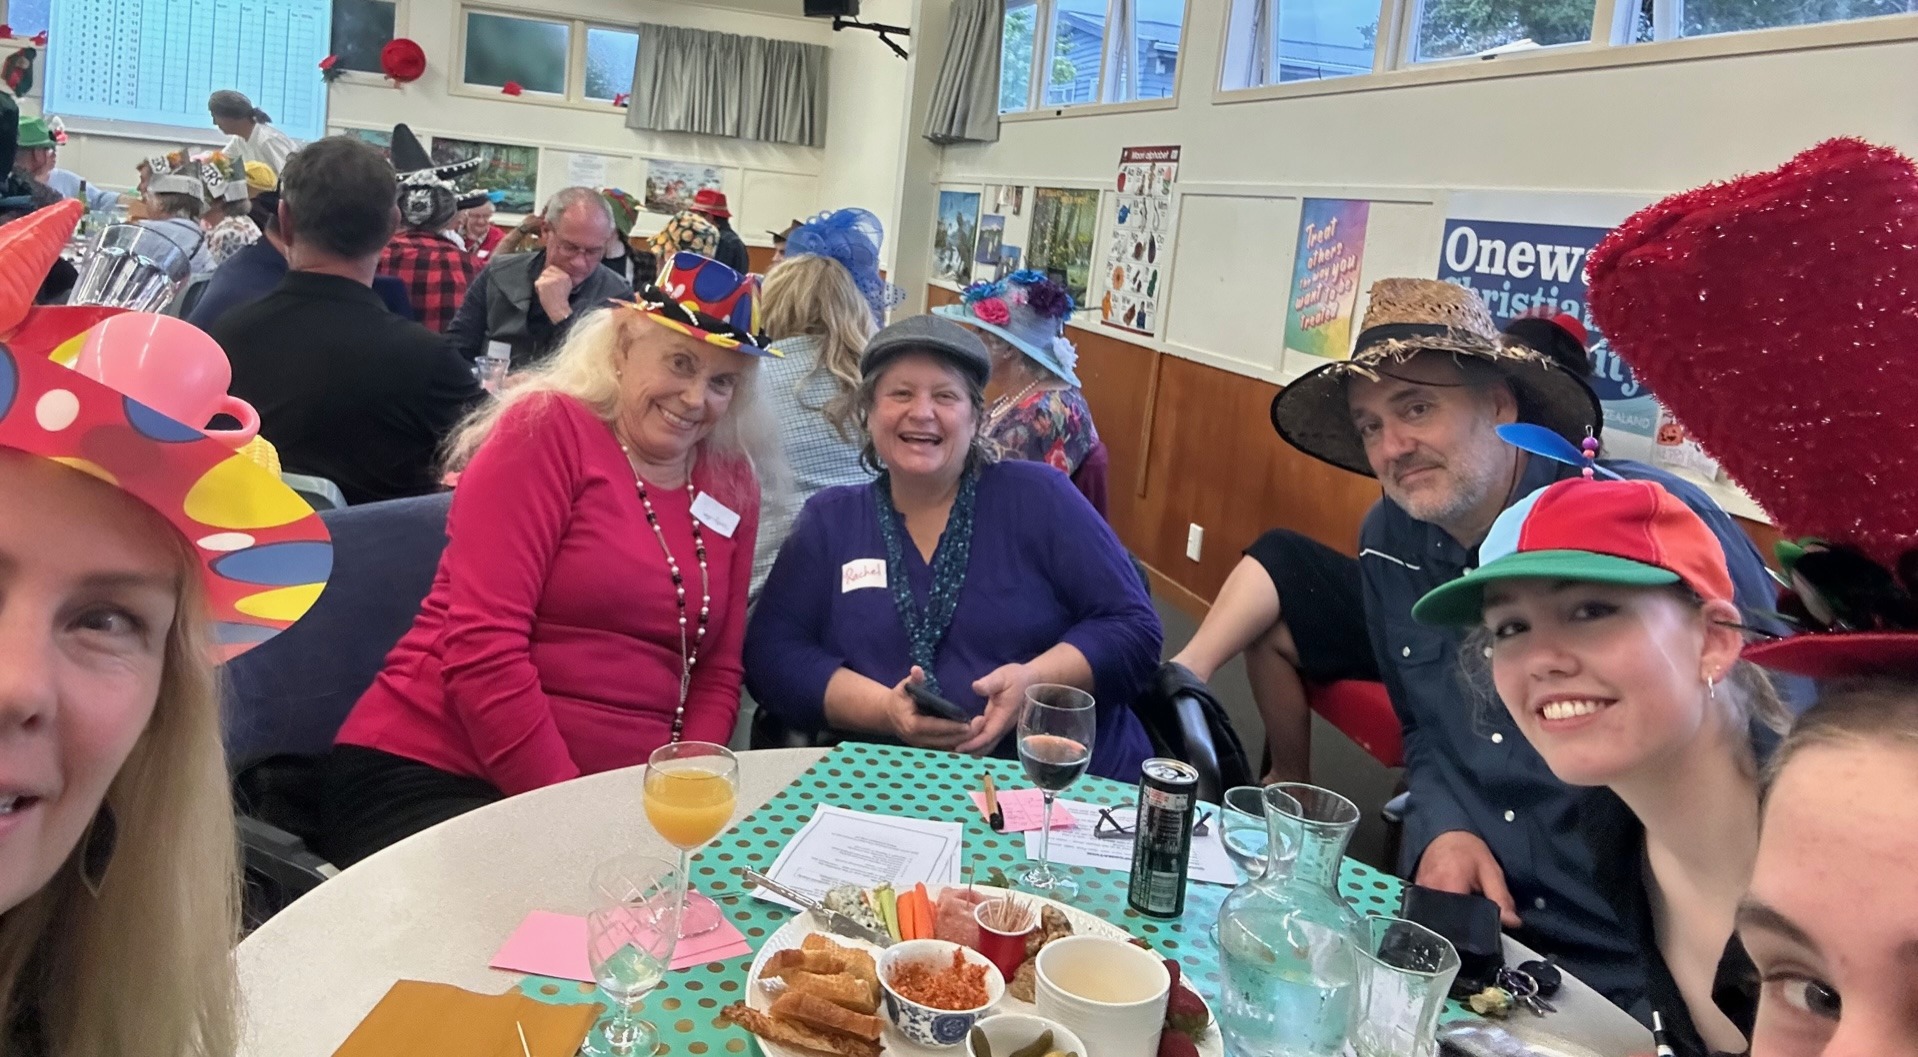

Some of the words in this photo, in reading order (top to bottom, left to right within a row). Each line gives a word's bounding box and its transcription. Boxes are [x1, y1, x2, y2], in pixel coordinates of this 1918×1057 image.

[1305, 216, 1338, 250] Treat
[1307, 241, 1343, 271] others
[1445, 225, 1593, 287] Onew
[1295, 282, 1323, 312] want
[845, 563, 882, 585] Rachel
